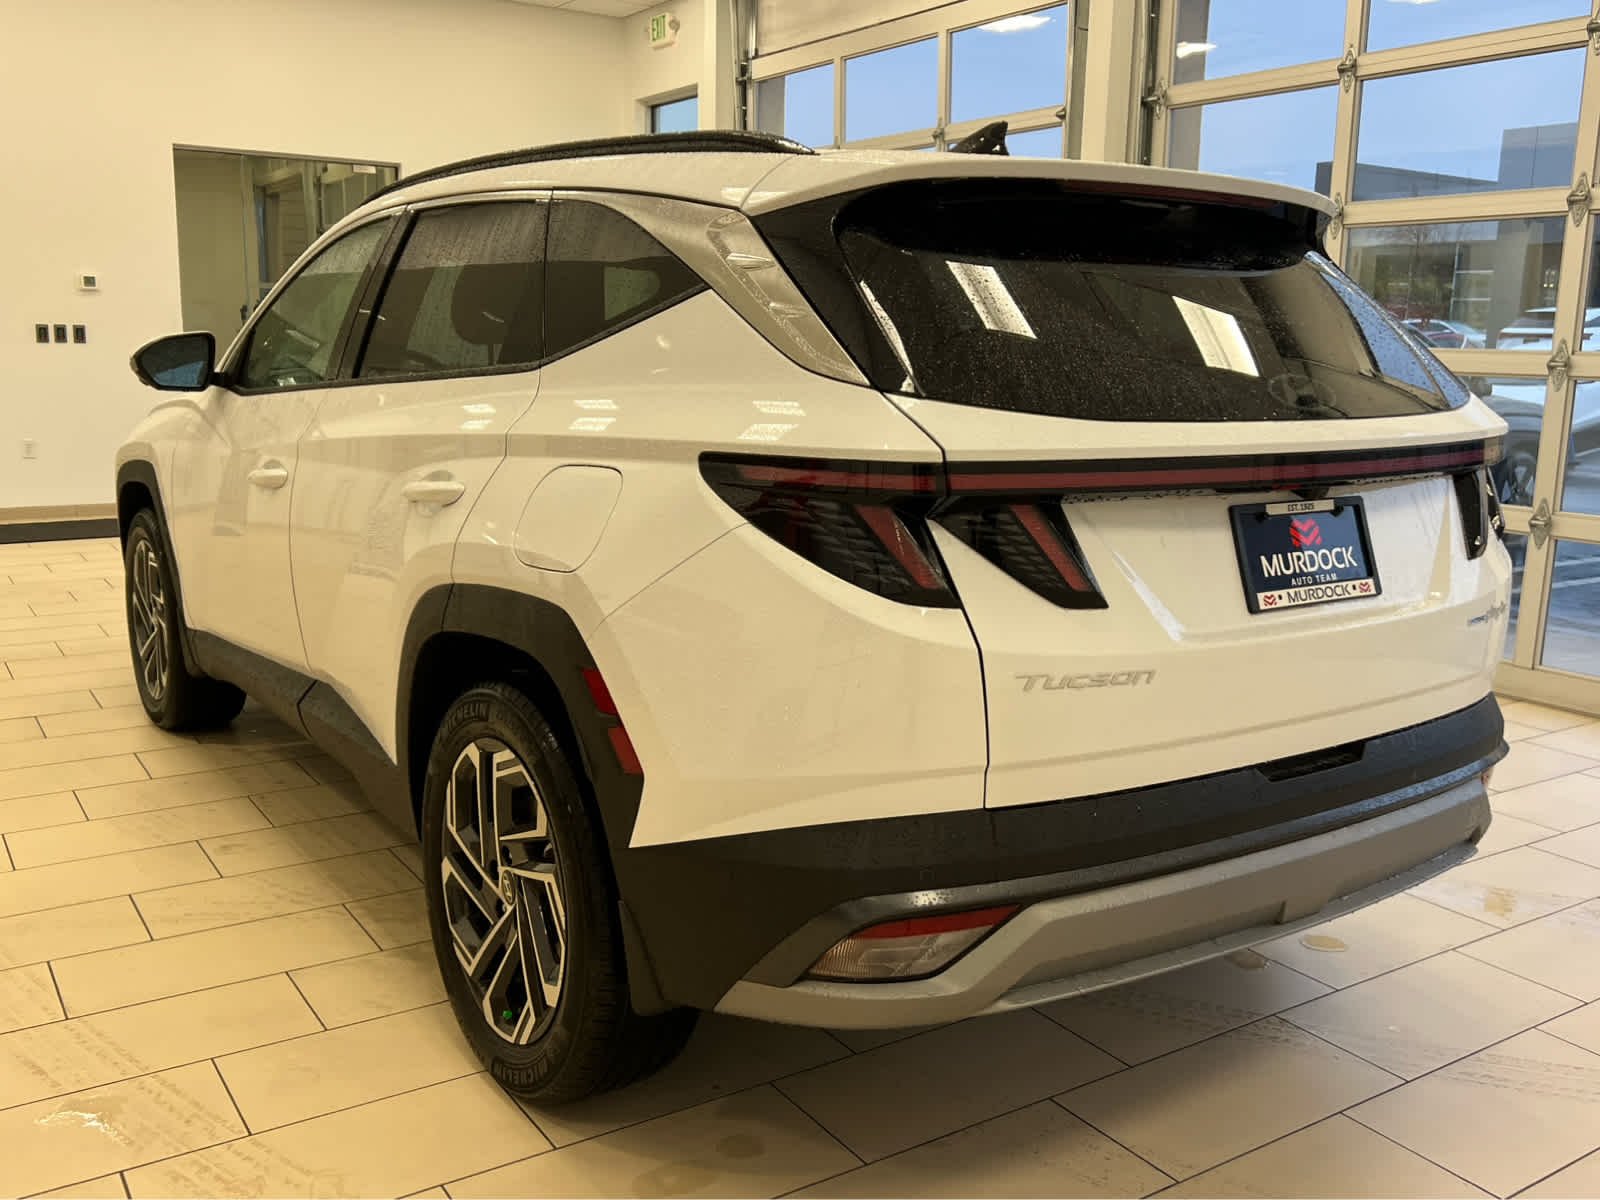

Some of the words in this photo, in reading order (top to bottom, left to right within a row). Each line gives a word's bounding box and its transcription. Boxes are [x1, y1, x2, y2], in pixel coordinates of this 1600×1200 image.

[1260, 546, 1358, 578] MURDOCK
[1291, 577, 1313, 587] AUTO
[1316, 573, 1337, 584] TEAM
[1287, 583, 1351, 604] MURDOCK
[1014, 669, 1156, 692] TUCSON
[494, 1057, 548, 1086] MICHELIN
